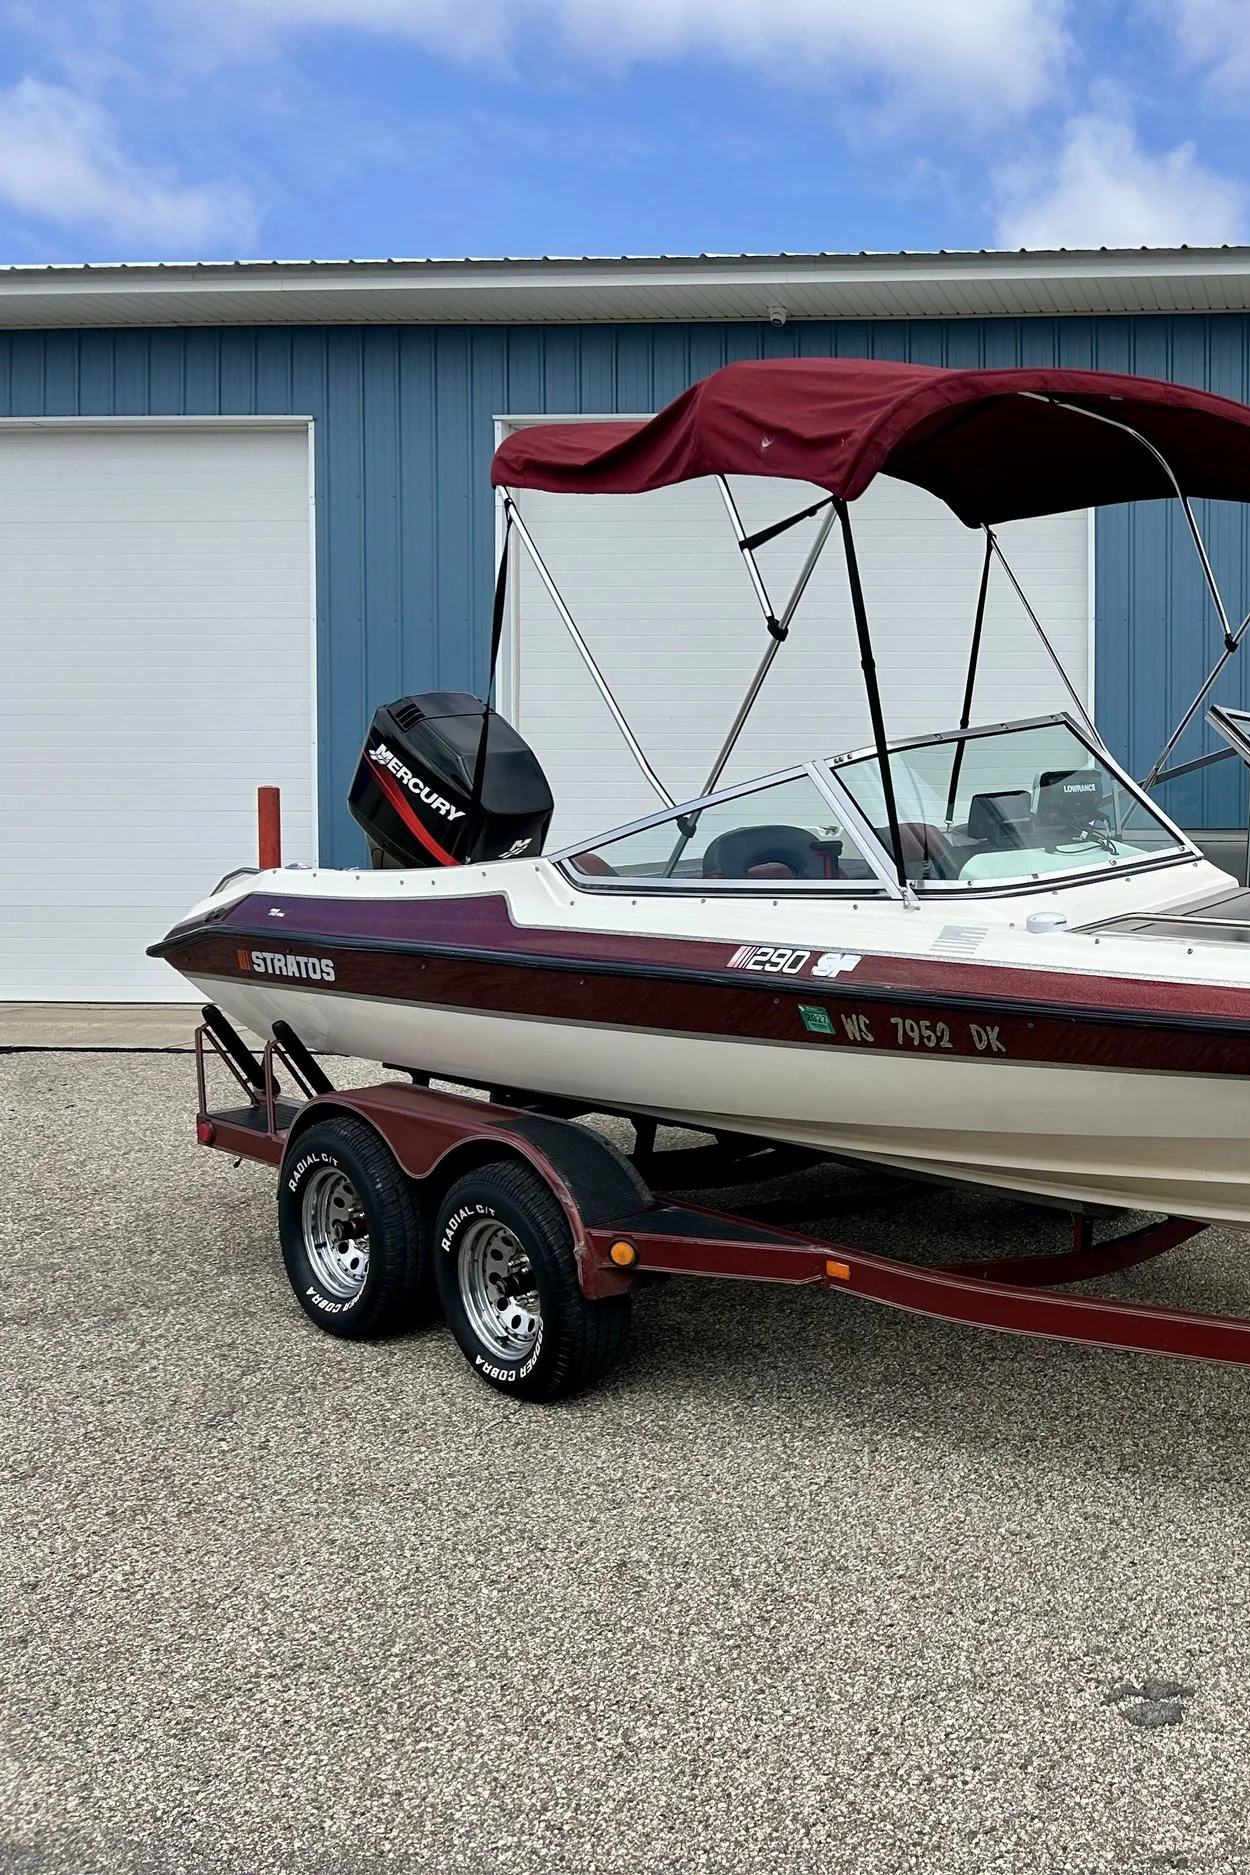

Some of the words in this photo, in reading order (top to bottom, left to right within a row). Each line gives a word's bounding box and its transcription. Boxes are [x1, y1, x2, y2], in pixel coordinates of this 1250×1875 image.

[370, 743, 466, 821] MERCURY
[1063, 783, 1096, 793] LOWRANCE
[251, 950, 336, 982] STRATOS
[745, 946, 811, 975] 290
[840, 1013, 875, 1042] WS
[890, 1016, 953, 1048] 7952
[969, 1023, 1007, 1053] DK
[288, 1153, 320, 1192] RADIAL
[441, 1206, 475, 1252] RADIAL
[306, 1286, 342, 1313] COBRA
[475, 1354, 516, 1382] COBRA
